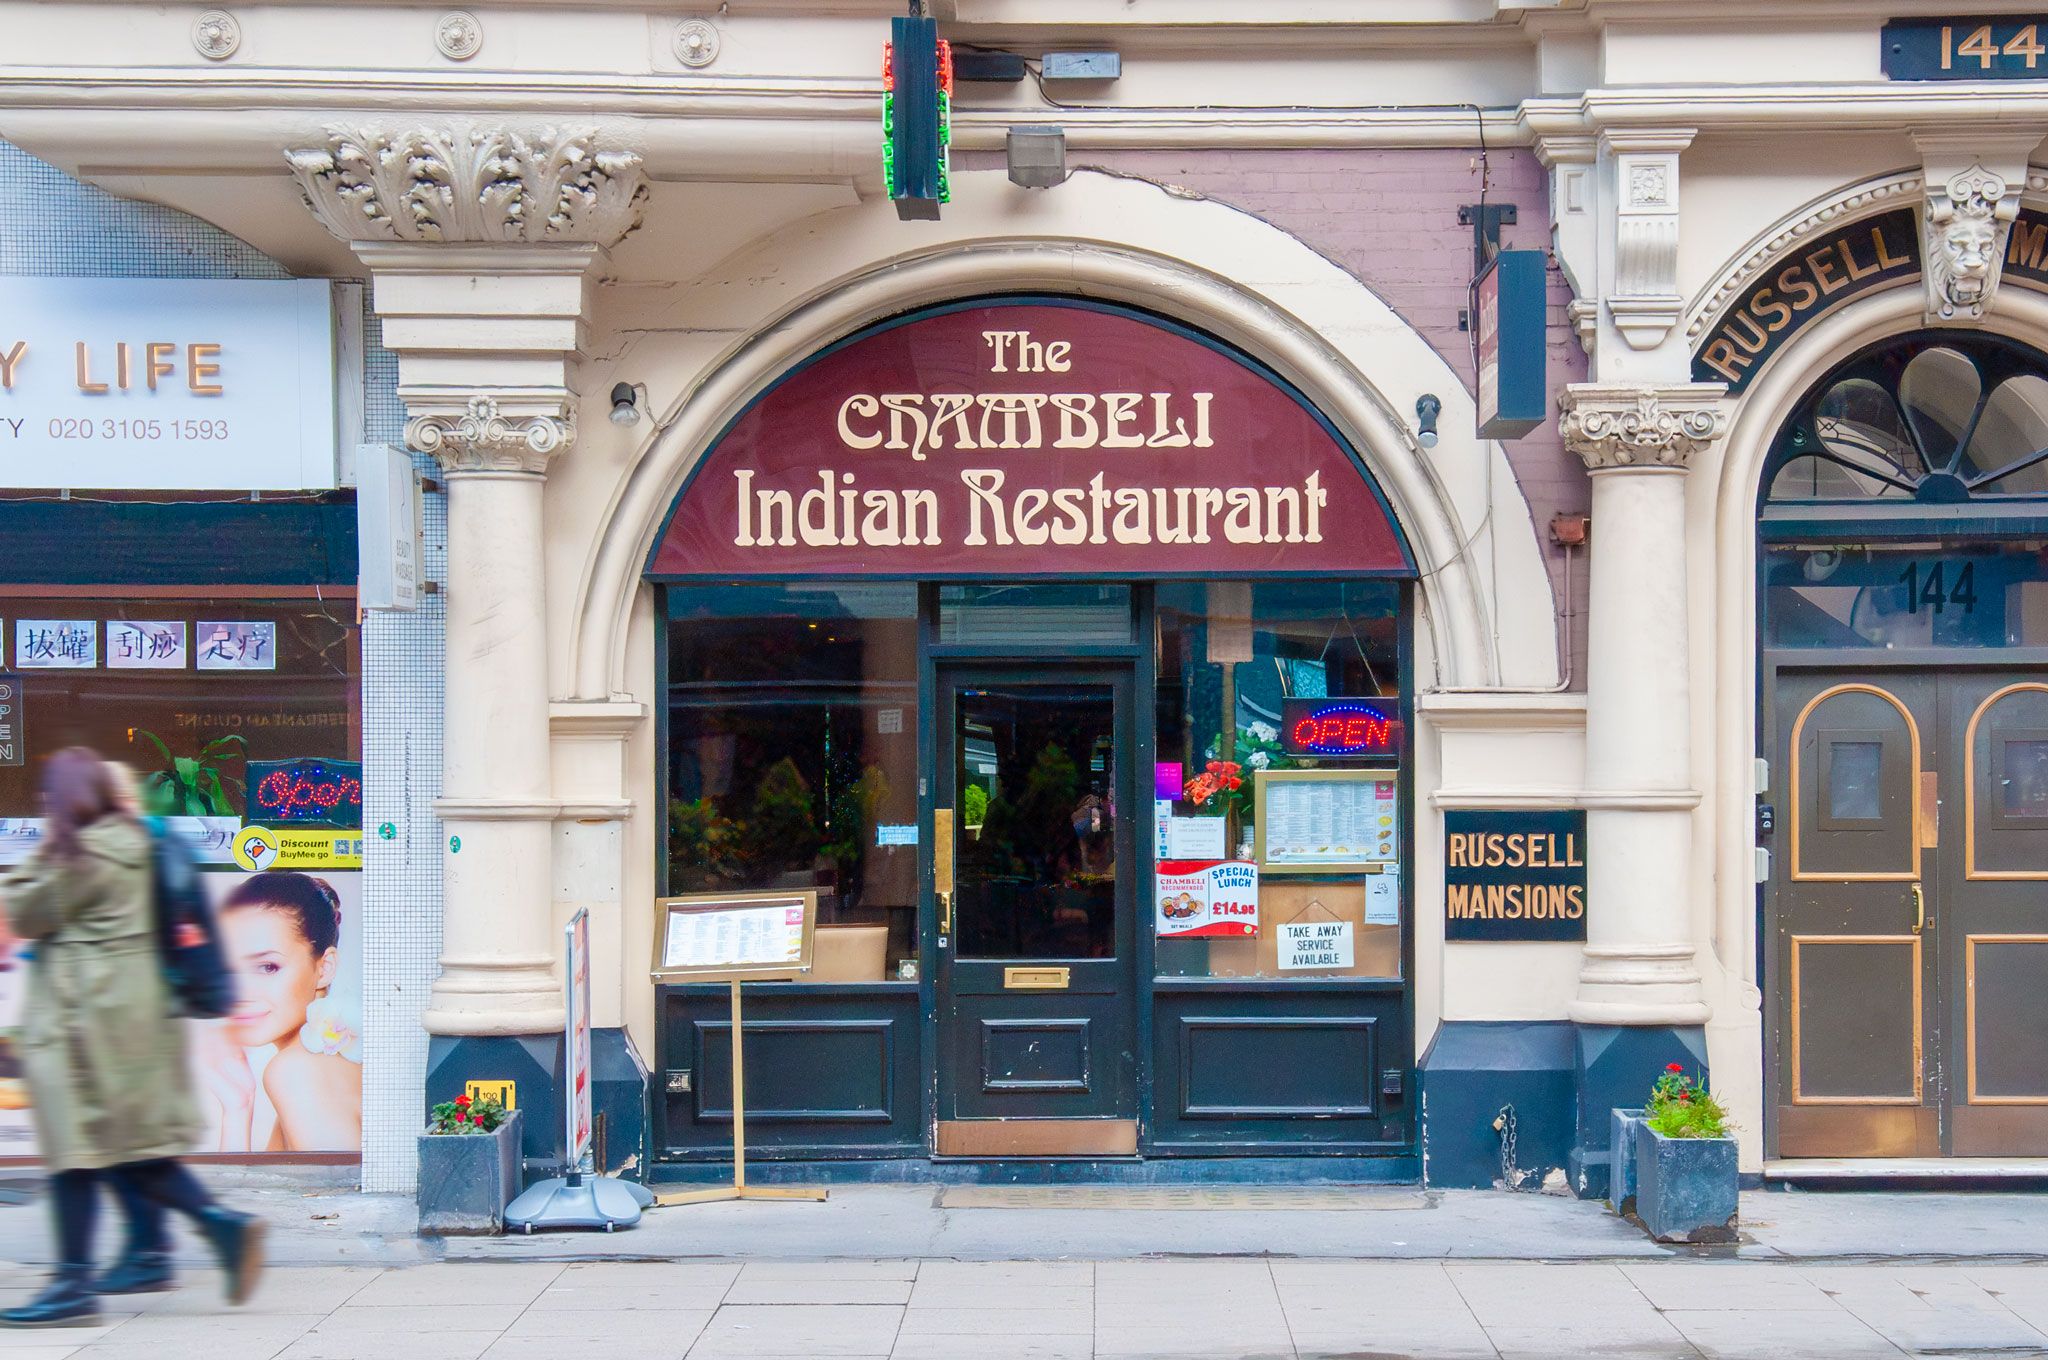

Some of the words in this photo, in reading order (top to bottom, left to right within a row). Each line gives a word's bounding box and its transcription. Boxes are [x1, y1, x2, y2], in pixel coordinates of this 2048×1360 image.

[1941, 25, 2045, 69] 144
[1701, 226, 1911, 383] RUSSELL
[76, 340, 224, 393] LIFE
[982, 331, 1072, 373] The
[49, 418, 94, 439] 020
[101, 418, 162, 440] 3105
[170, 419, 228, 440] 1593
[837, 392, 1214, 461] CHAMBELI
[733, 469, 942, 547] Indian
[960, 468, 1327, 546] Restaurant
[1899, 560, 1978, 614] 144
[24, 628, 89, 660] 拔罐
[115, 630, 178, 660] 刮痧
[206, 631, 267, 661] 足疗
[1294, 719, 1390, 746] OPEN
[258, 770, 361, 818] Open
[281, 839, 330, 848] Discount
[281, 851, 316, 860] BuyMee
[317, 852, 329, 860] go
[1449, 832, 1584, 868] RUSSELL
[1212, 867, 1255, 879] SPECIAL
[1217, 878, 1252, 889] LUNCH
[1212, 902, 1255, 915] £14.95
[1448, 883, 1584, 919] MANSIONS
[1287, 926, 1310, 938] TAKE
[1317, 925, 1343, 937] AWAY
[1296, 939, 1334, 951] SERVICE
[1292, 953, 1340, 966] AVAILABLE
[483, 1092, 498, 1100] 100
